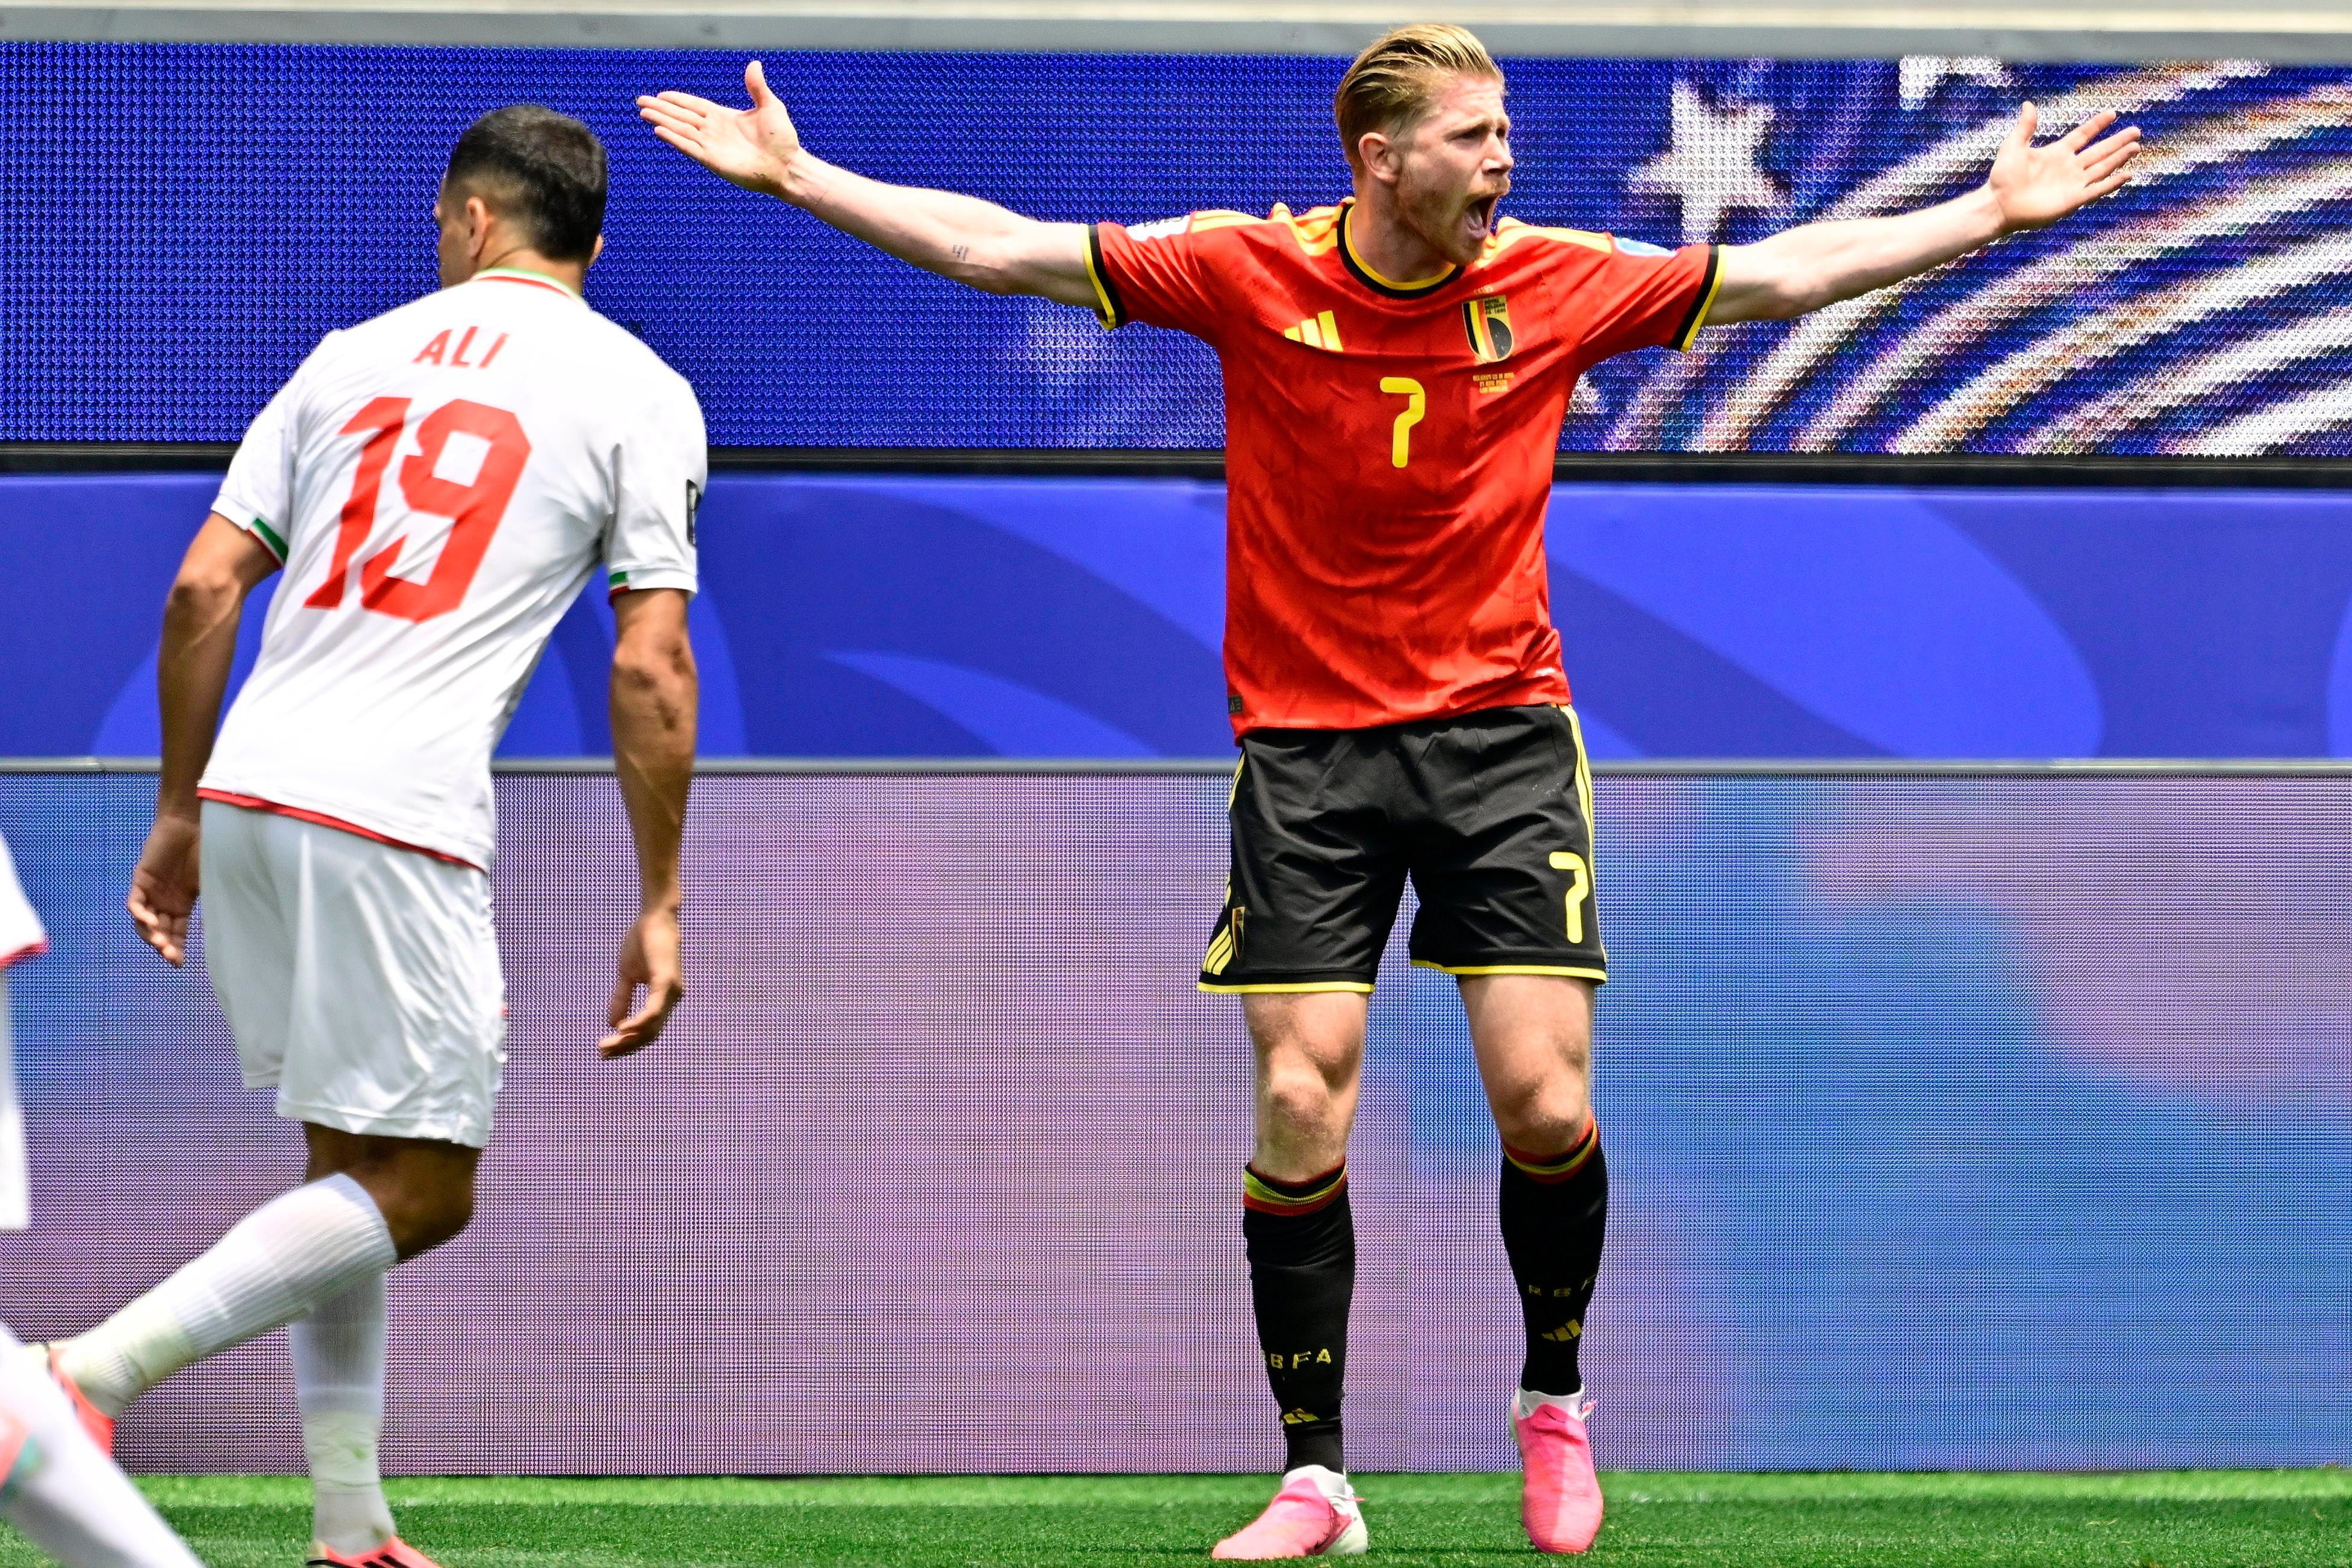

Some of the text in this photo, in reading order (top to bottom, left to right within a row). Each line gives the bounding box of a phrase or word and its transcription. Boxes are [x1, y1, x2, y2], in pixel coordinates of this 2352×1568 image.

[413, 326, 510, 369] ALI
[1379, 376, 1426, 468] 7
[303, 396, 532, 623] 19
[1549, 850, 1589, 944] 7
